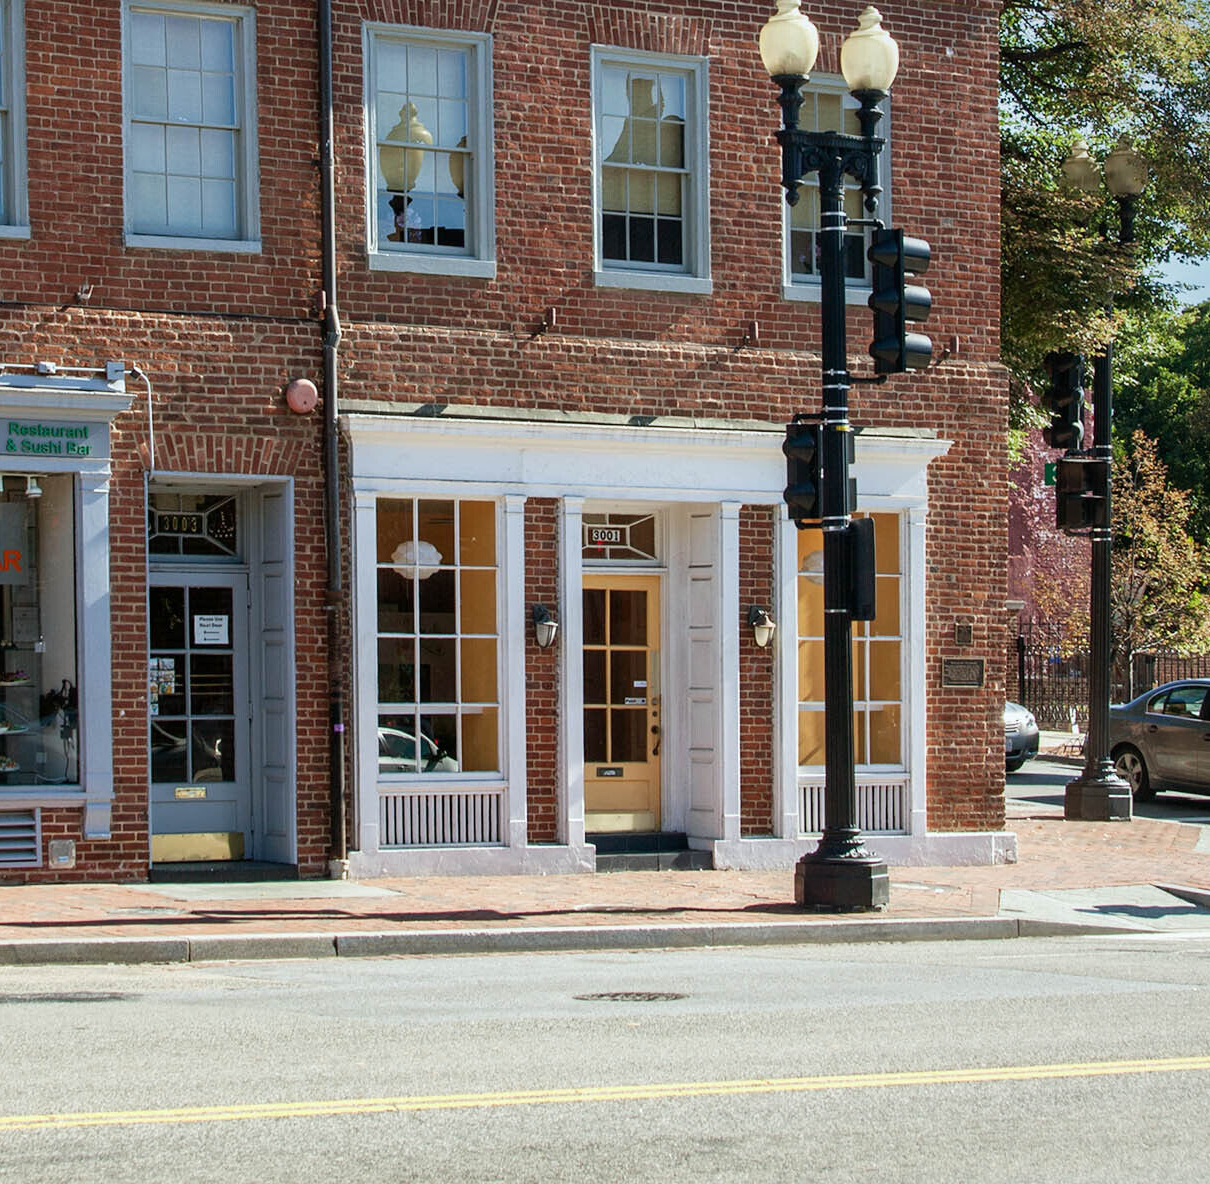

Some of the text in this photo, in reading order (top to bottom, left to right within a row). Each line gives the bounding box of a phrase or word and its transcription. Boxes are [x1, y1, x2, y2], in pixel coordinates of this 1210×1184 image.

[8, 422, 89, 439] Restaurant
[6, 439, 92, 456] & Sushi Bar
[163, 516, 197, 532] 3003
[593, 530, 618, 541] 3001
